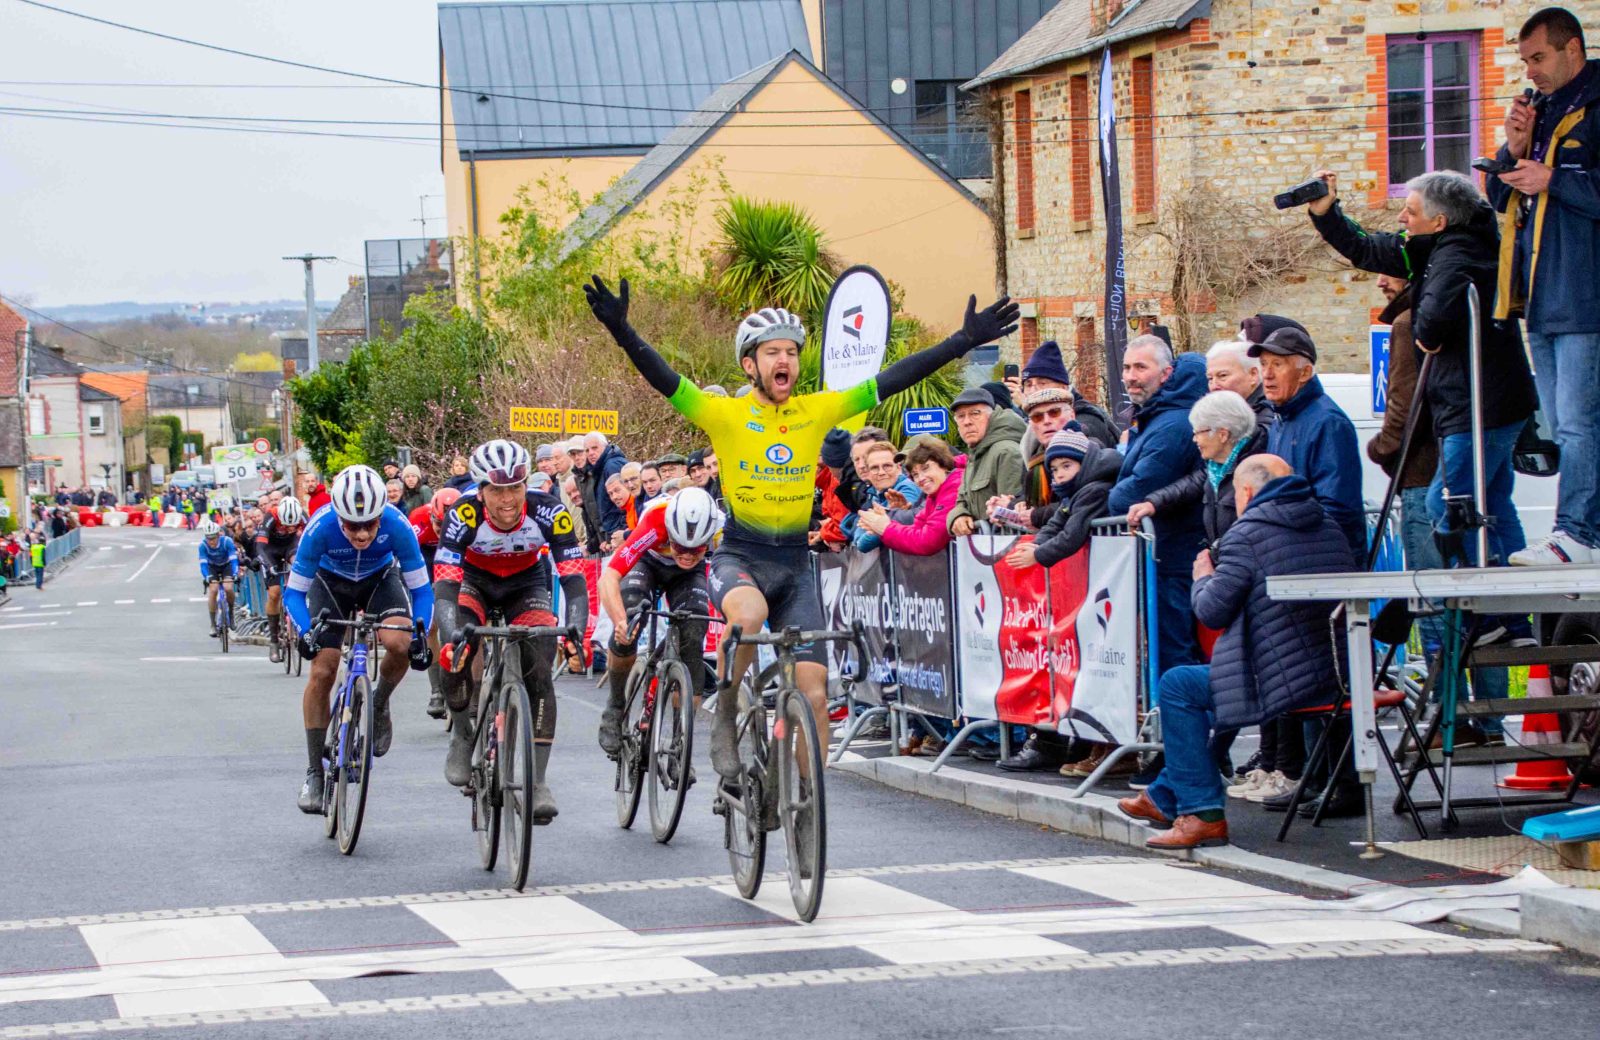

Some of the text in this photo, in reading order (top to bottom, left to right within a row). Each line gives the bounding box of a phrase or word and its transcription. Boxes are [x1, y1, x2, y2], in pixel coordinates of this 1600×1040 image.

[513, 411, 615, 431] PASSAGE PIETONS
[228, 465, 247, 479] 50
[898, 584, 946, 644] Bretagne
